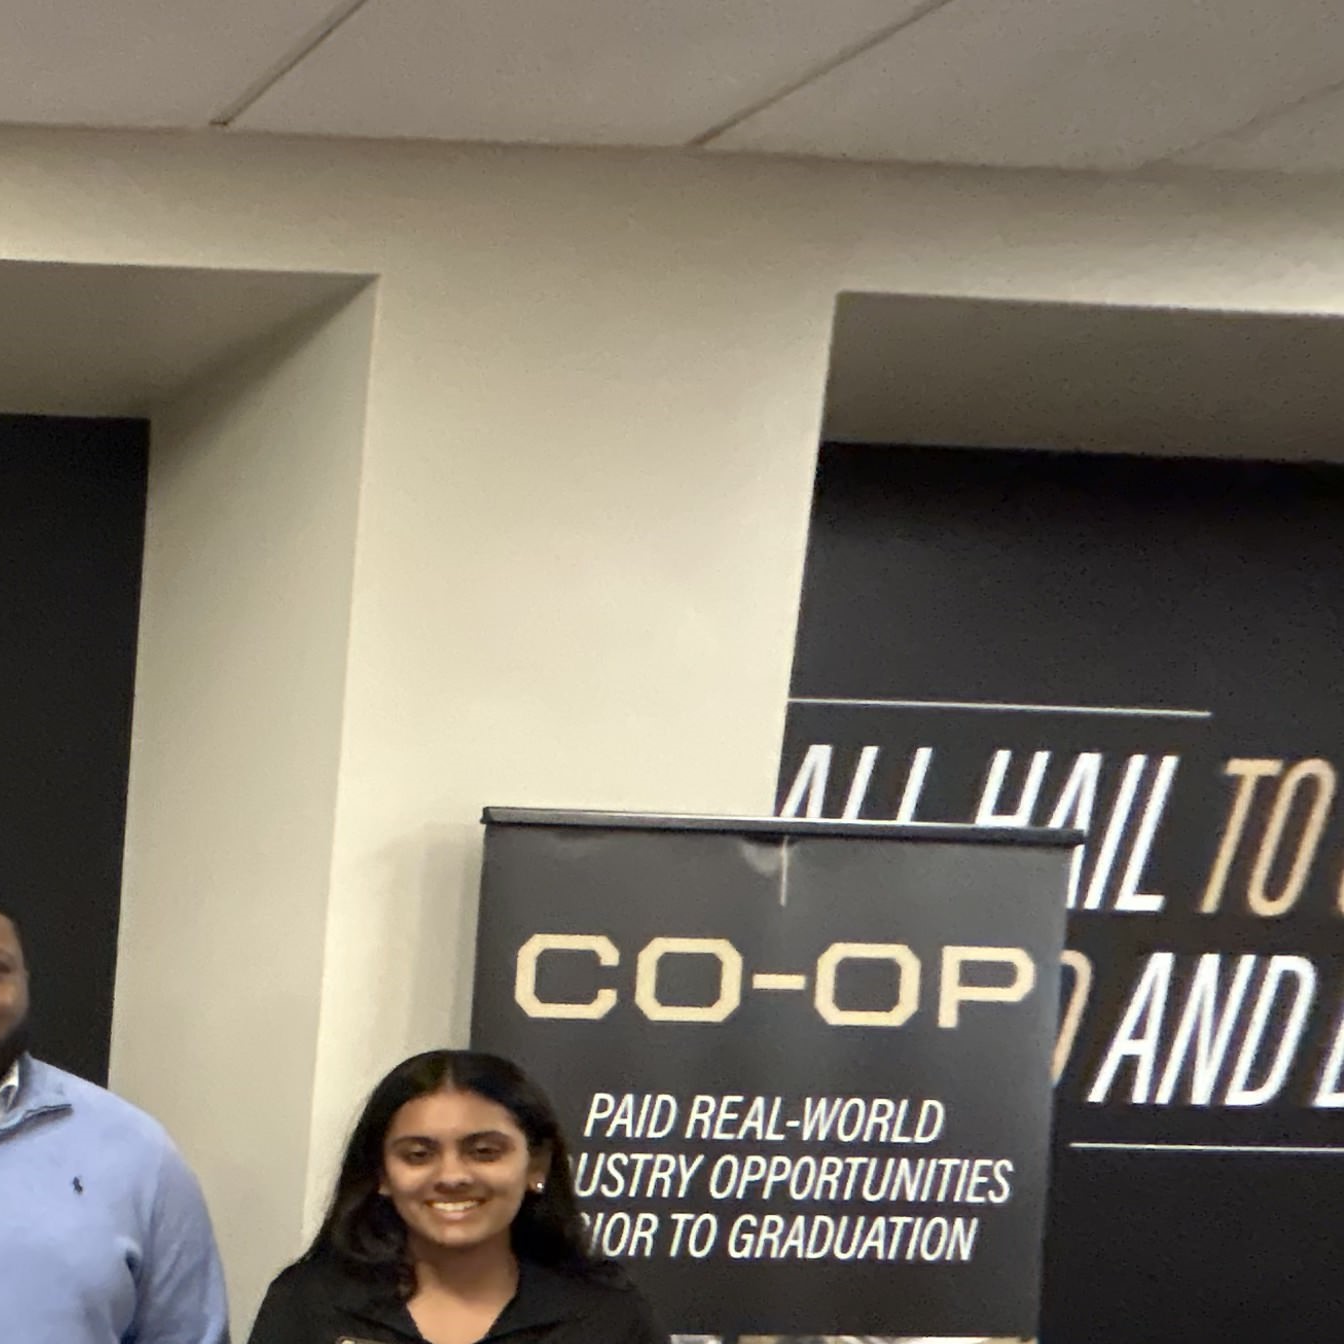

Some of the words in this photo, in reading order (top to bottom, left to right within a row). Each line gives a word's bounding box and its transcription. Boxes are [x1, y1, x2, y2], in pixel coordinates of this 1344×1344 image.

[1200, 757, 1336, 917] TO
[514, 933, 1036, 1029] CO-OP
[1088, 952, 1316, 1107] AND
[583, 1093, 677, 1139] PAID
[684, 1094, 945, 1143] REAL-WORLD
[568, 1153, 704, 1198] USTRY
[709, 1154, 1014, 1205] OPPORTUNITIES
[580, 1212, 659, 1257] IOR
[669, 1213, 718, 1258] TO
[728, 1213, 981, 1263] GRADUATION
